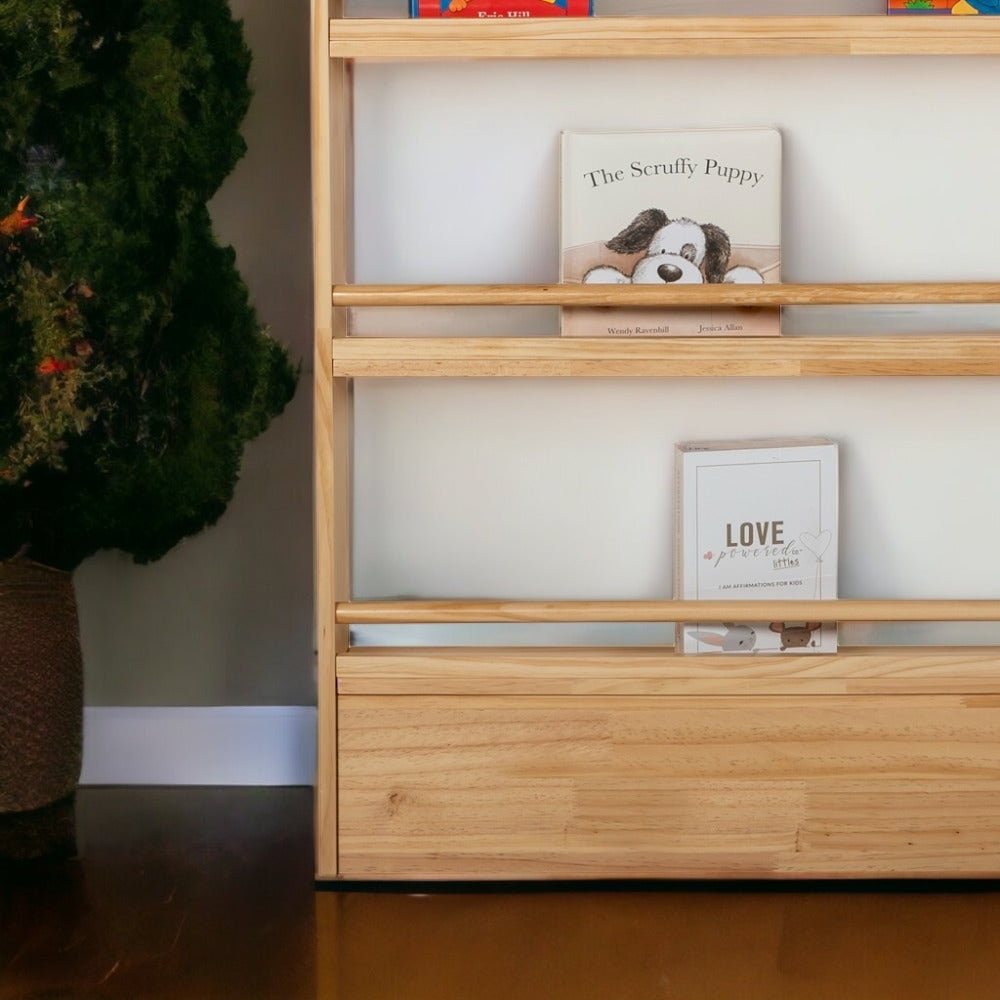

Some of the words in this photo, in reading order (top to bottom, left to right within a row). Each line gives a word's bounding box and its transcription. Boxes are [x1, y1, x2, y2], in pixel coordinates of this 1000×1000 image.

[583, 168, 625, 188] The
[630, 157, 698, 180] Scruffy
[704, 158, 765, 188] Puppy
[606, 326, 634, 335] Wendy
[697, 323, 722, 334] Jessica
[726, 520, 785, 547] LOVE
